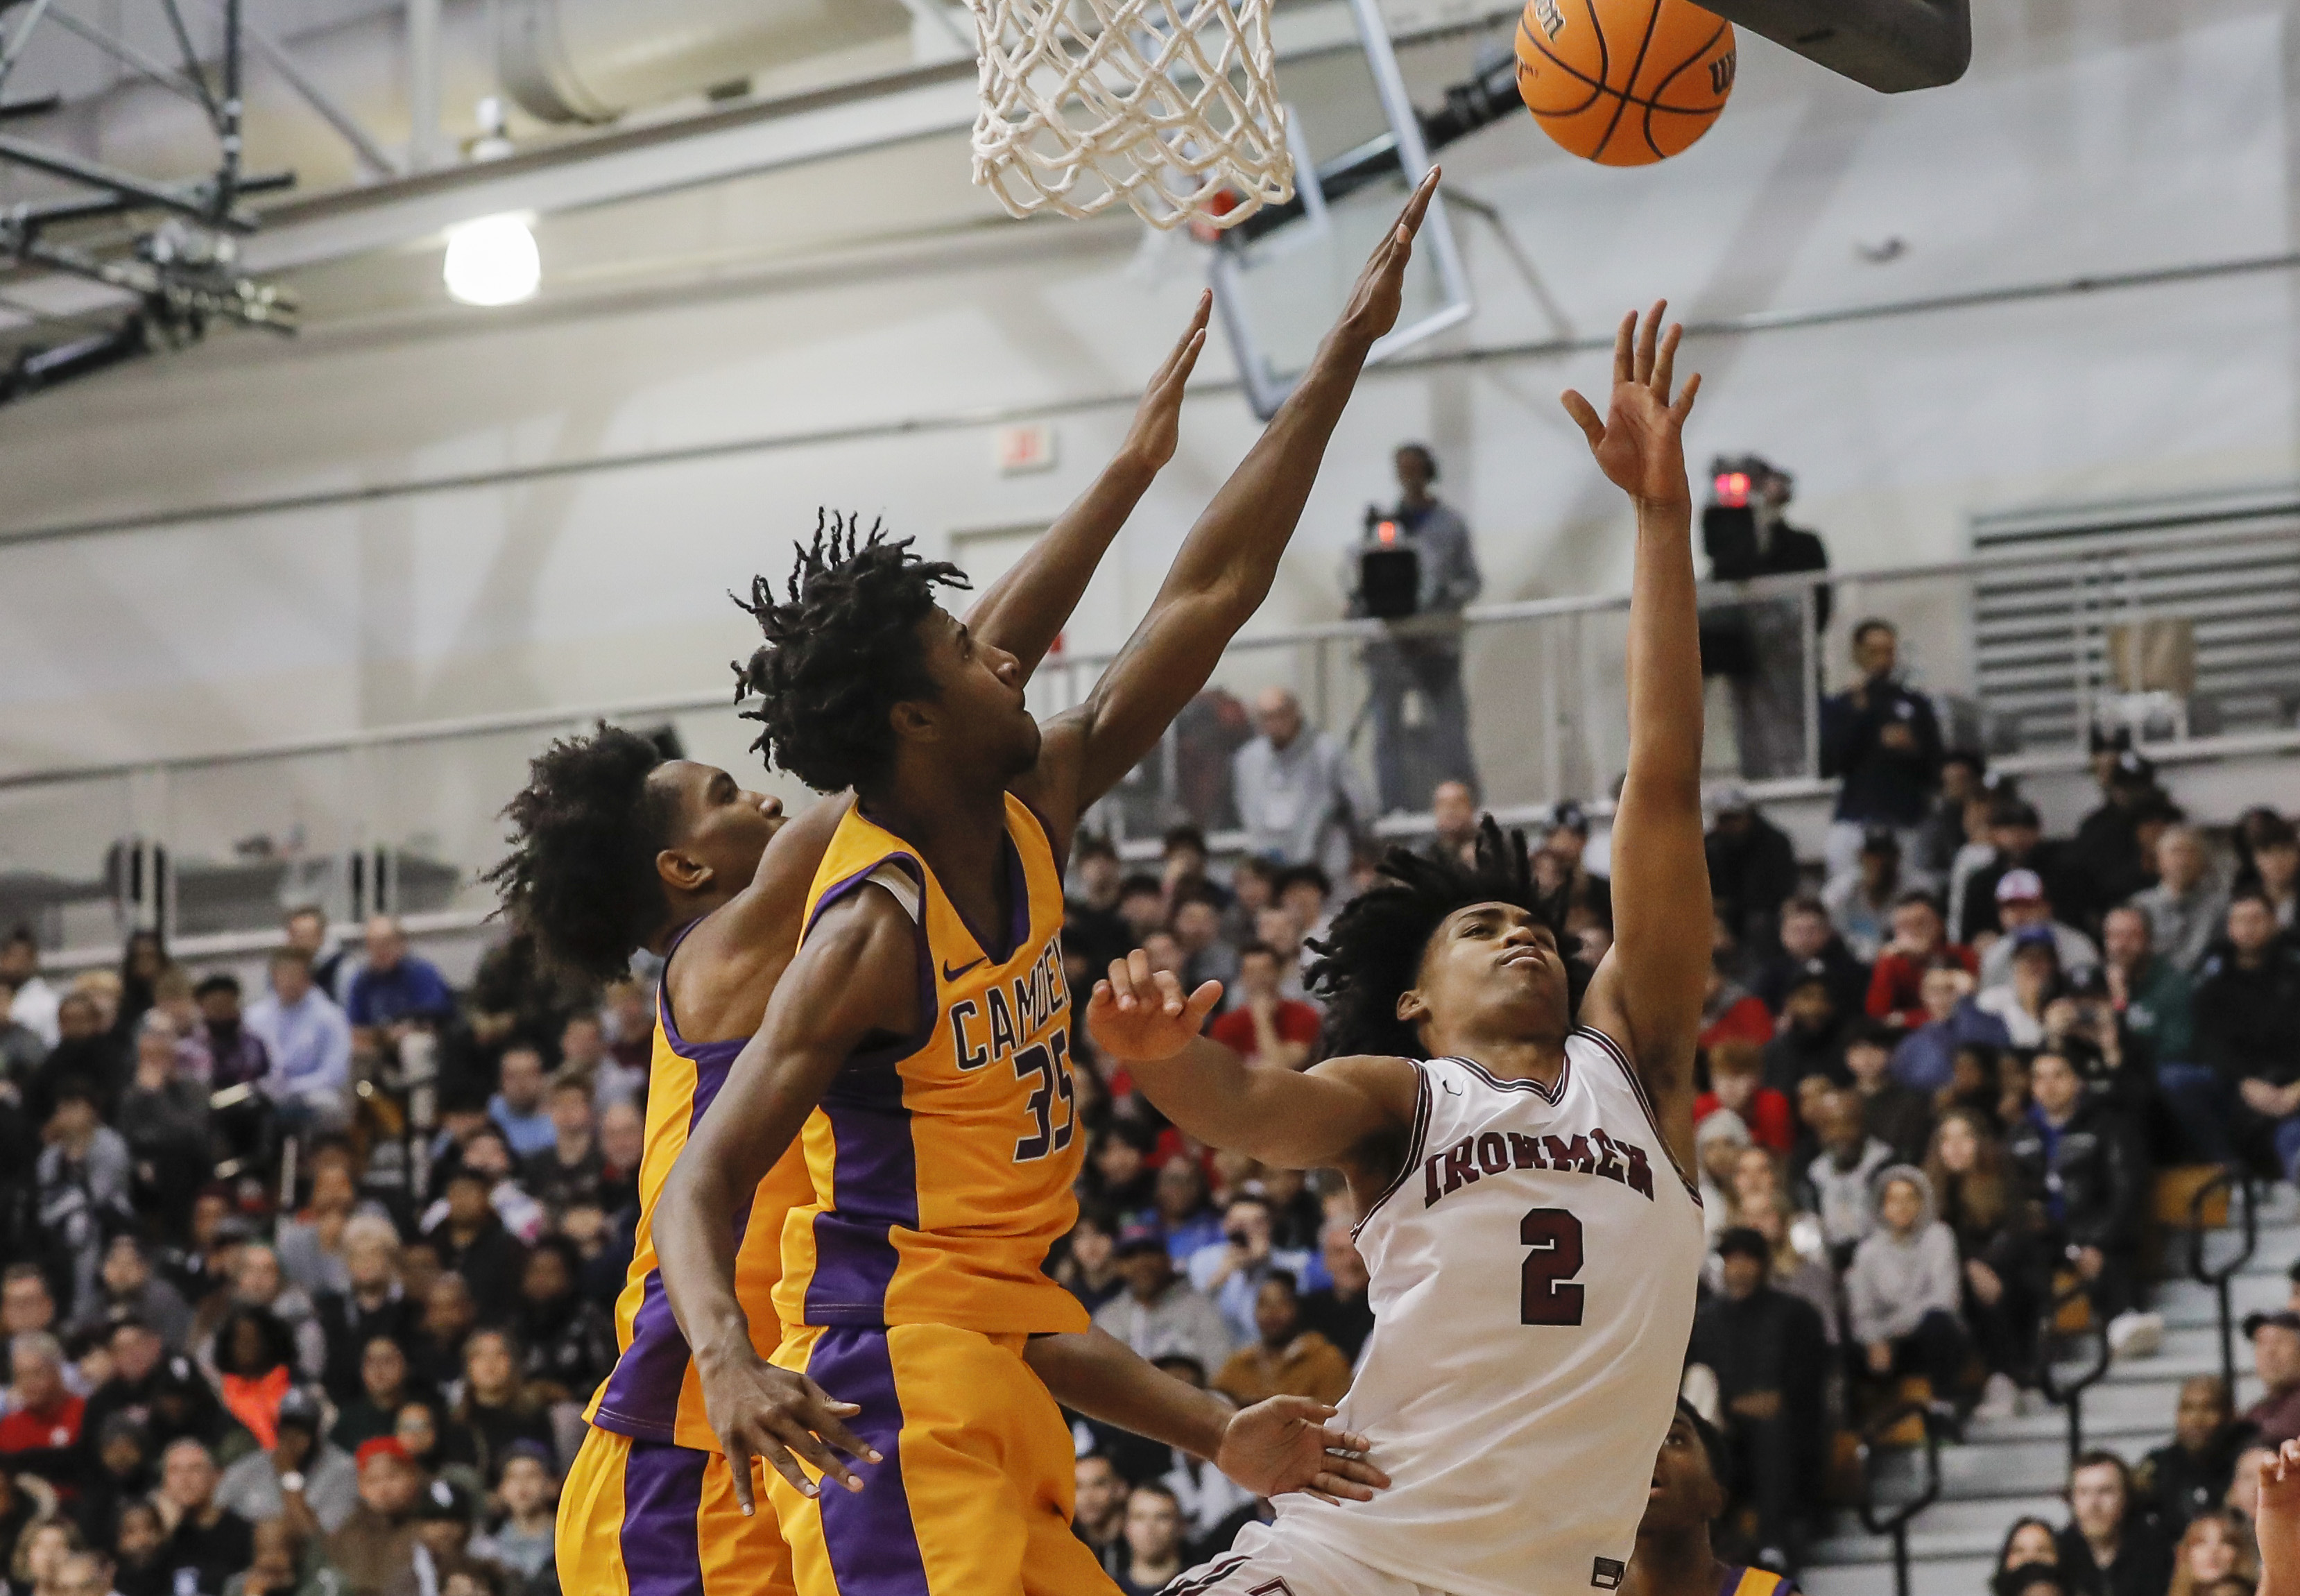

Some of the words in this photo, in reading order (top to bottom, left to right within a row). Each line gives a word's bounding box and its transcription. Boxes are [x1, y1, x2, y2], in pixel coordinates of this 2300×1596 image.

[1012, 1029, 1074, 1162] 35
[1424, 1128, 1655, 1209] IRONMEN
[1520, 1208, 1585, 1325] 2
